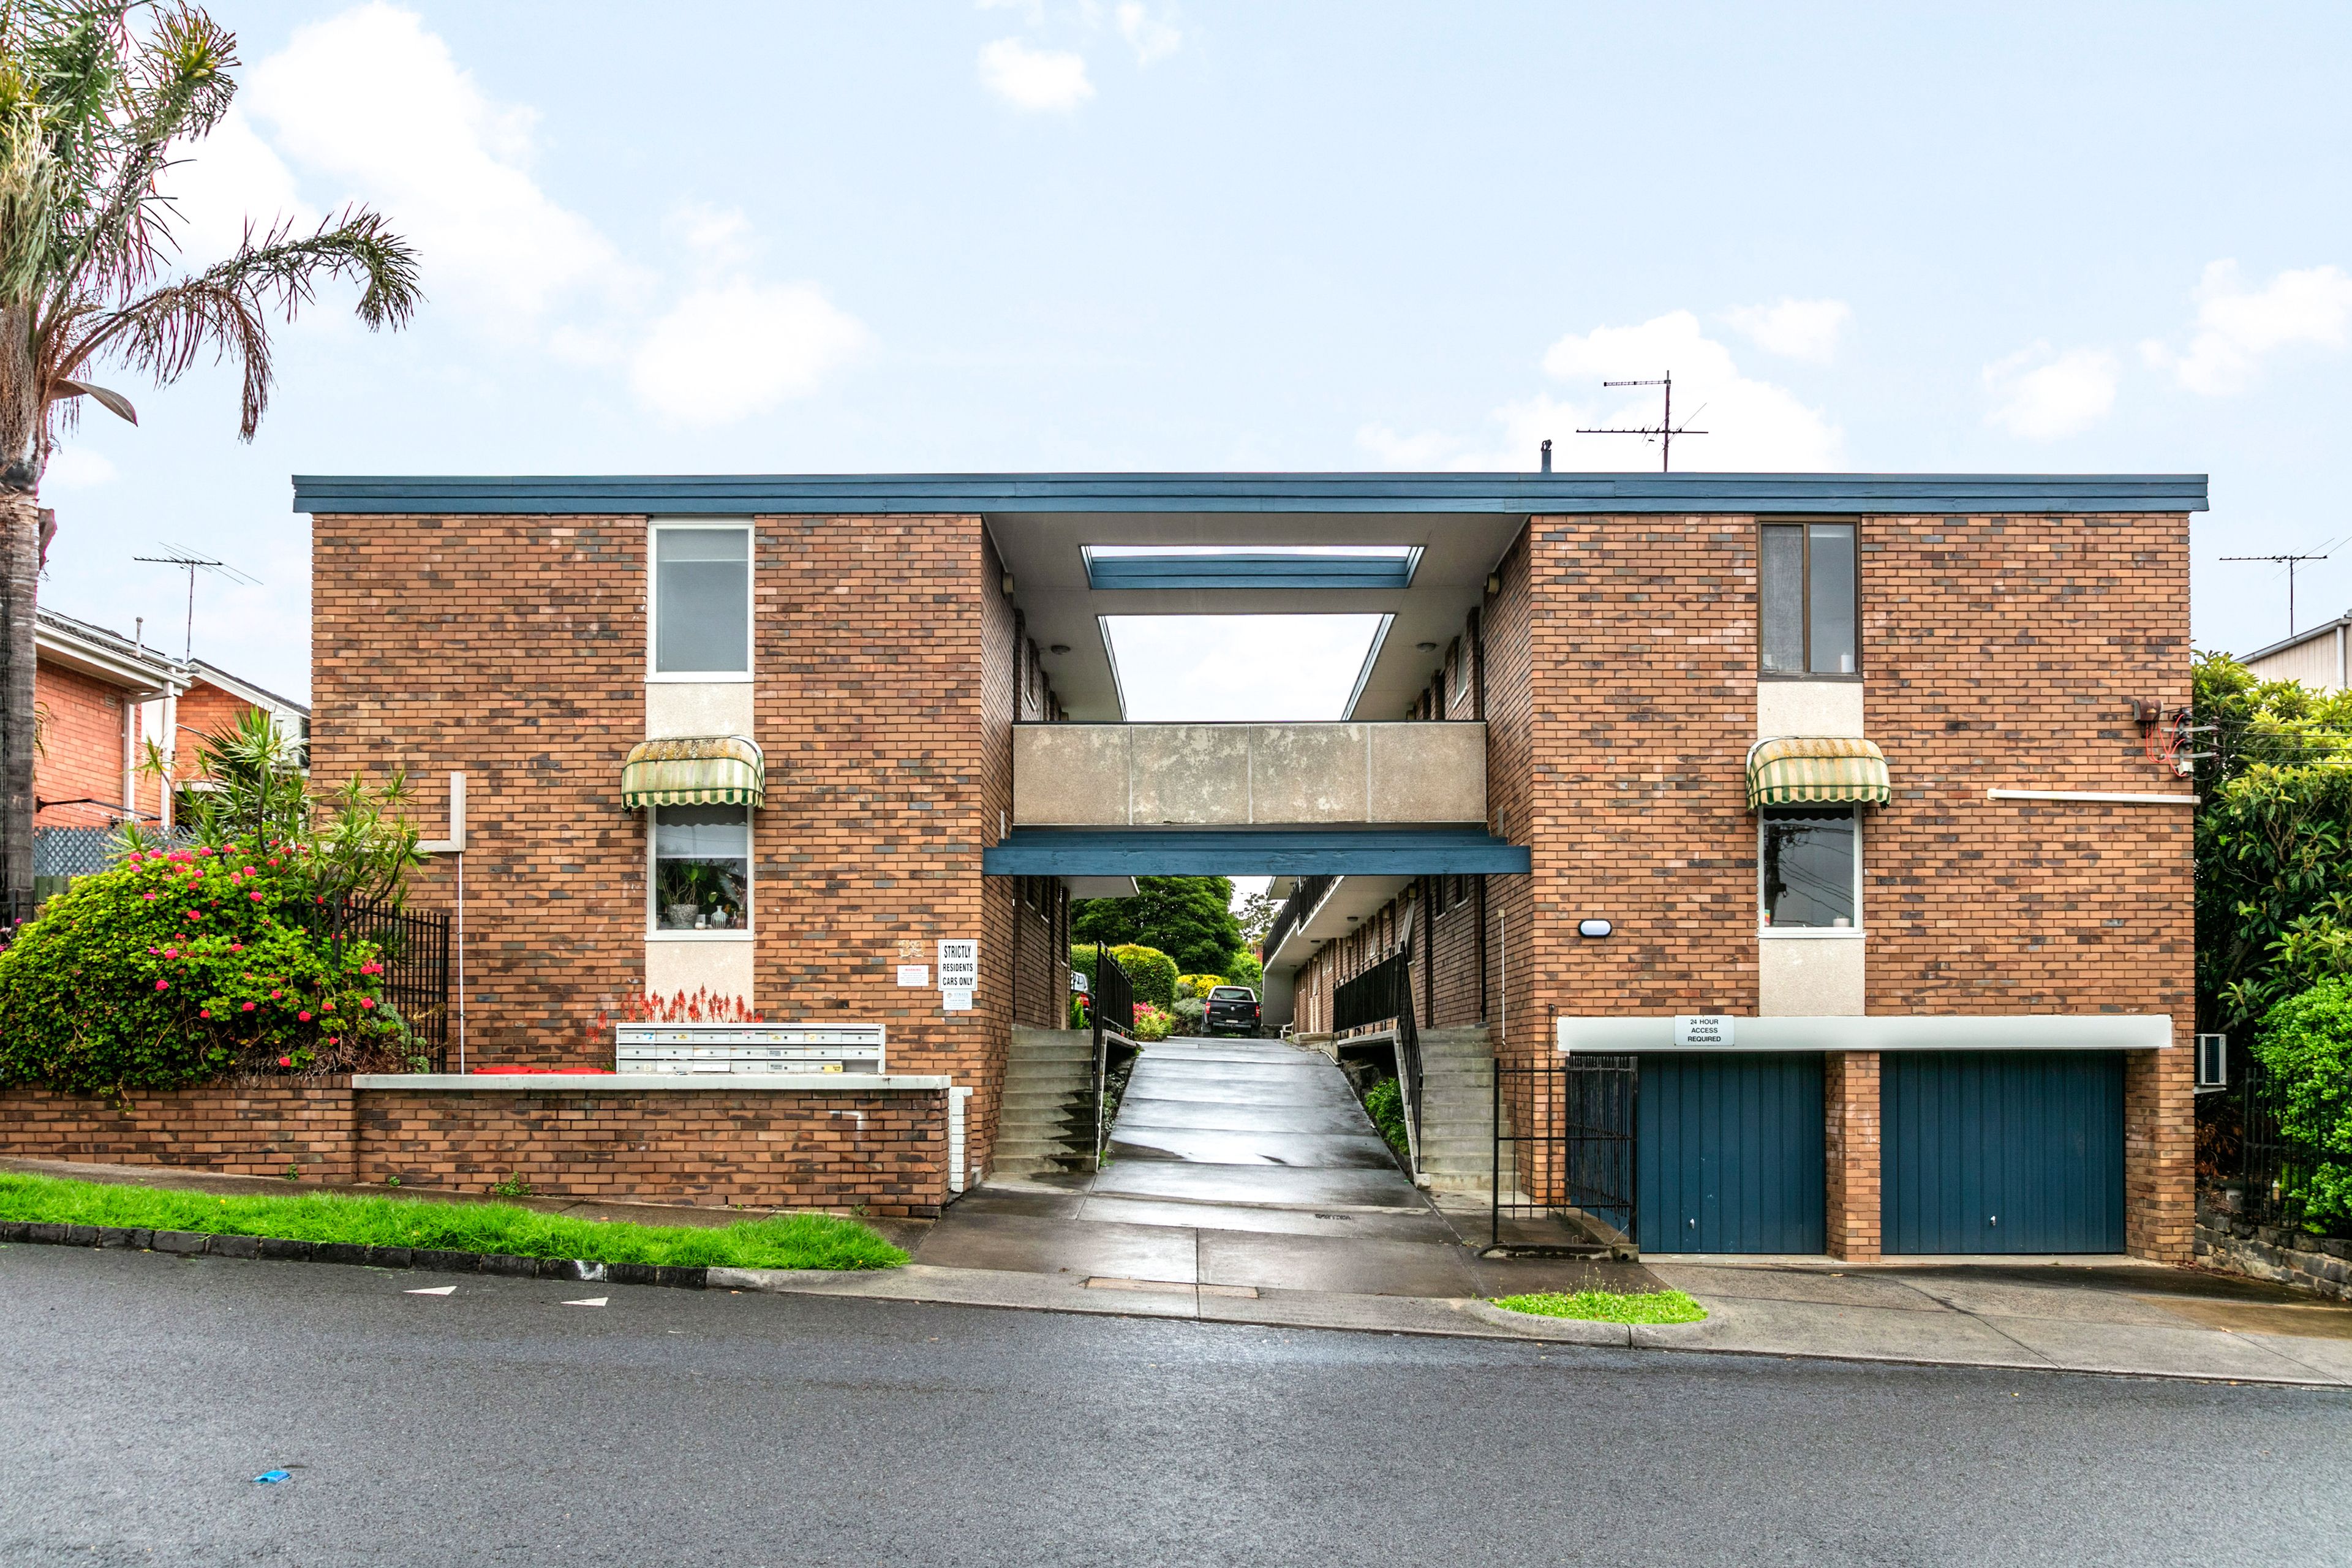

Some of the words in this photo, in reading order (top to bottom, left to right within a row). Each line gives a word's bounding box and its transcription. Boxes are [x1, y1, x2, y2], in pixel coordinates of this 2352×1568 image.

[944, 945, 971, 959] STRICTLY
[943, 963, 973, 972] RESIDENTS
[943, 977, 958, 986] CARS
[959, 977, 973, 986] ONLY
